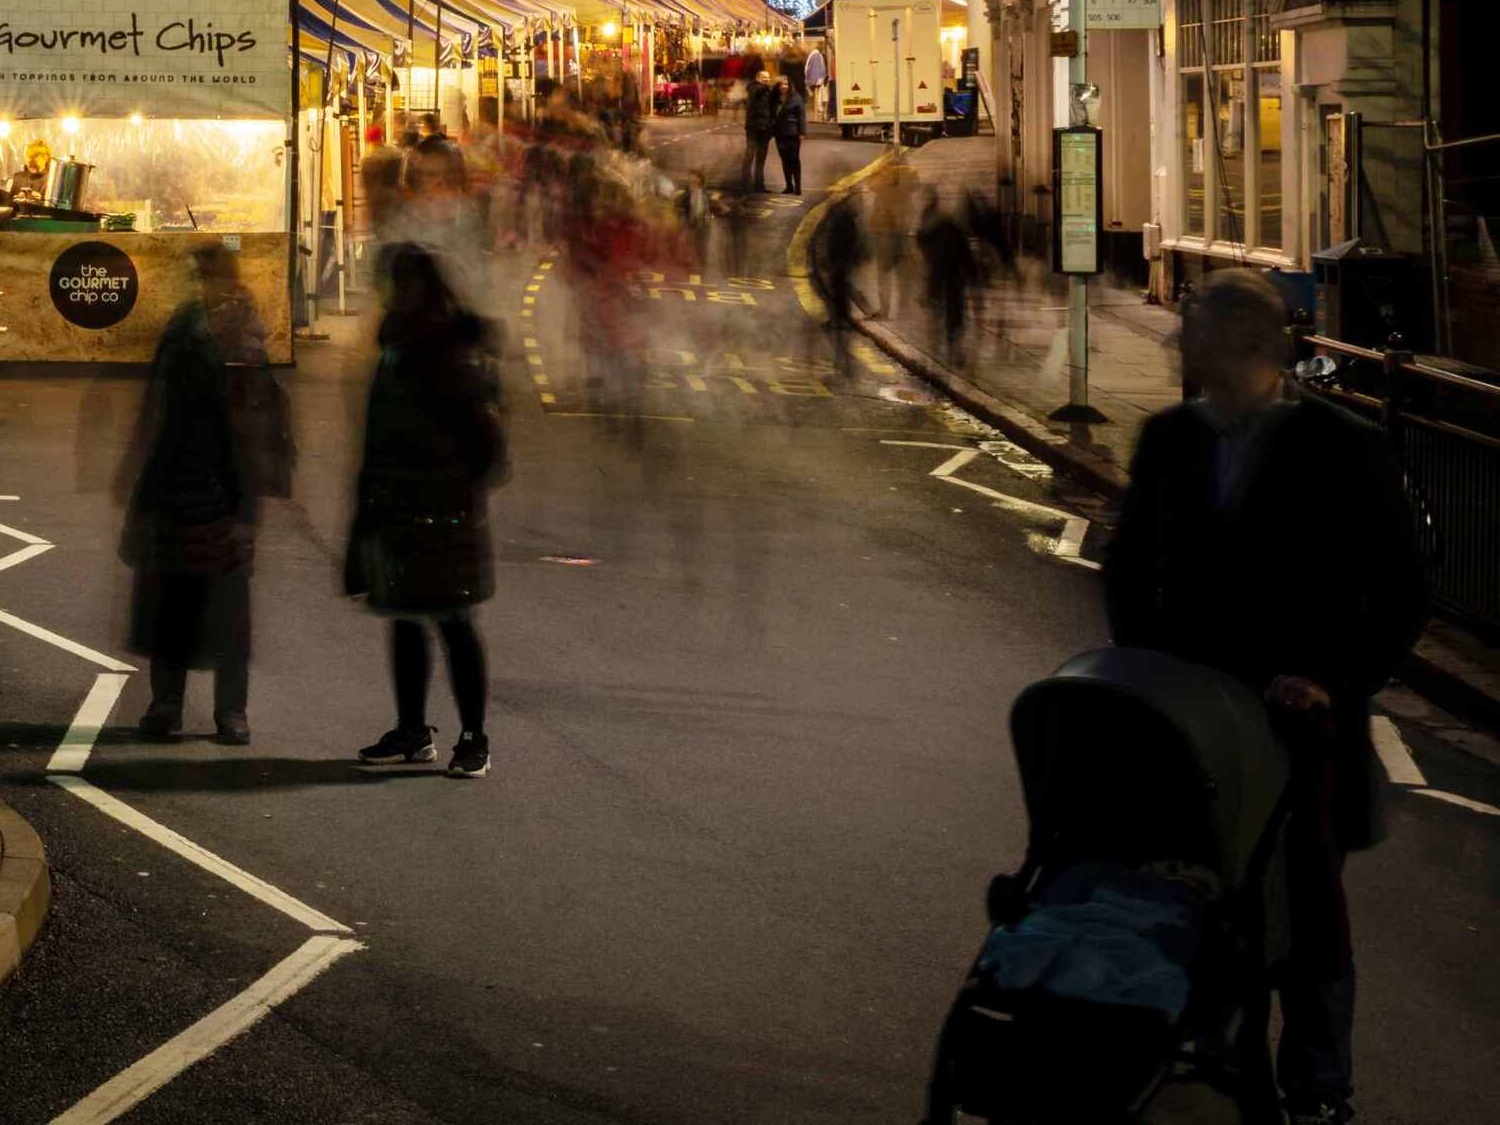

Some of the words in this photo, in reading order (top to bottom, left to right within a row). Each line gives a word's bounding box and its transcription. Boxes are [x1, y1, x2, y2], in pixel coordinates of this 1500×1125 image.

[156, 18, 257, 67] Chips
[83, 74, 116, 82] FROM
[124, 74, 175, 82] AROUND
[183, 75, 205, 83] THE
[212, 75, 256, 84] WORLD
[81, 264, 107, 277] the
[59, 277, 130, 290] GOURMET
[69, 291, 98, 305] chip
[101, 292, 119, 303] co
